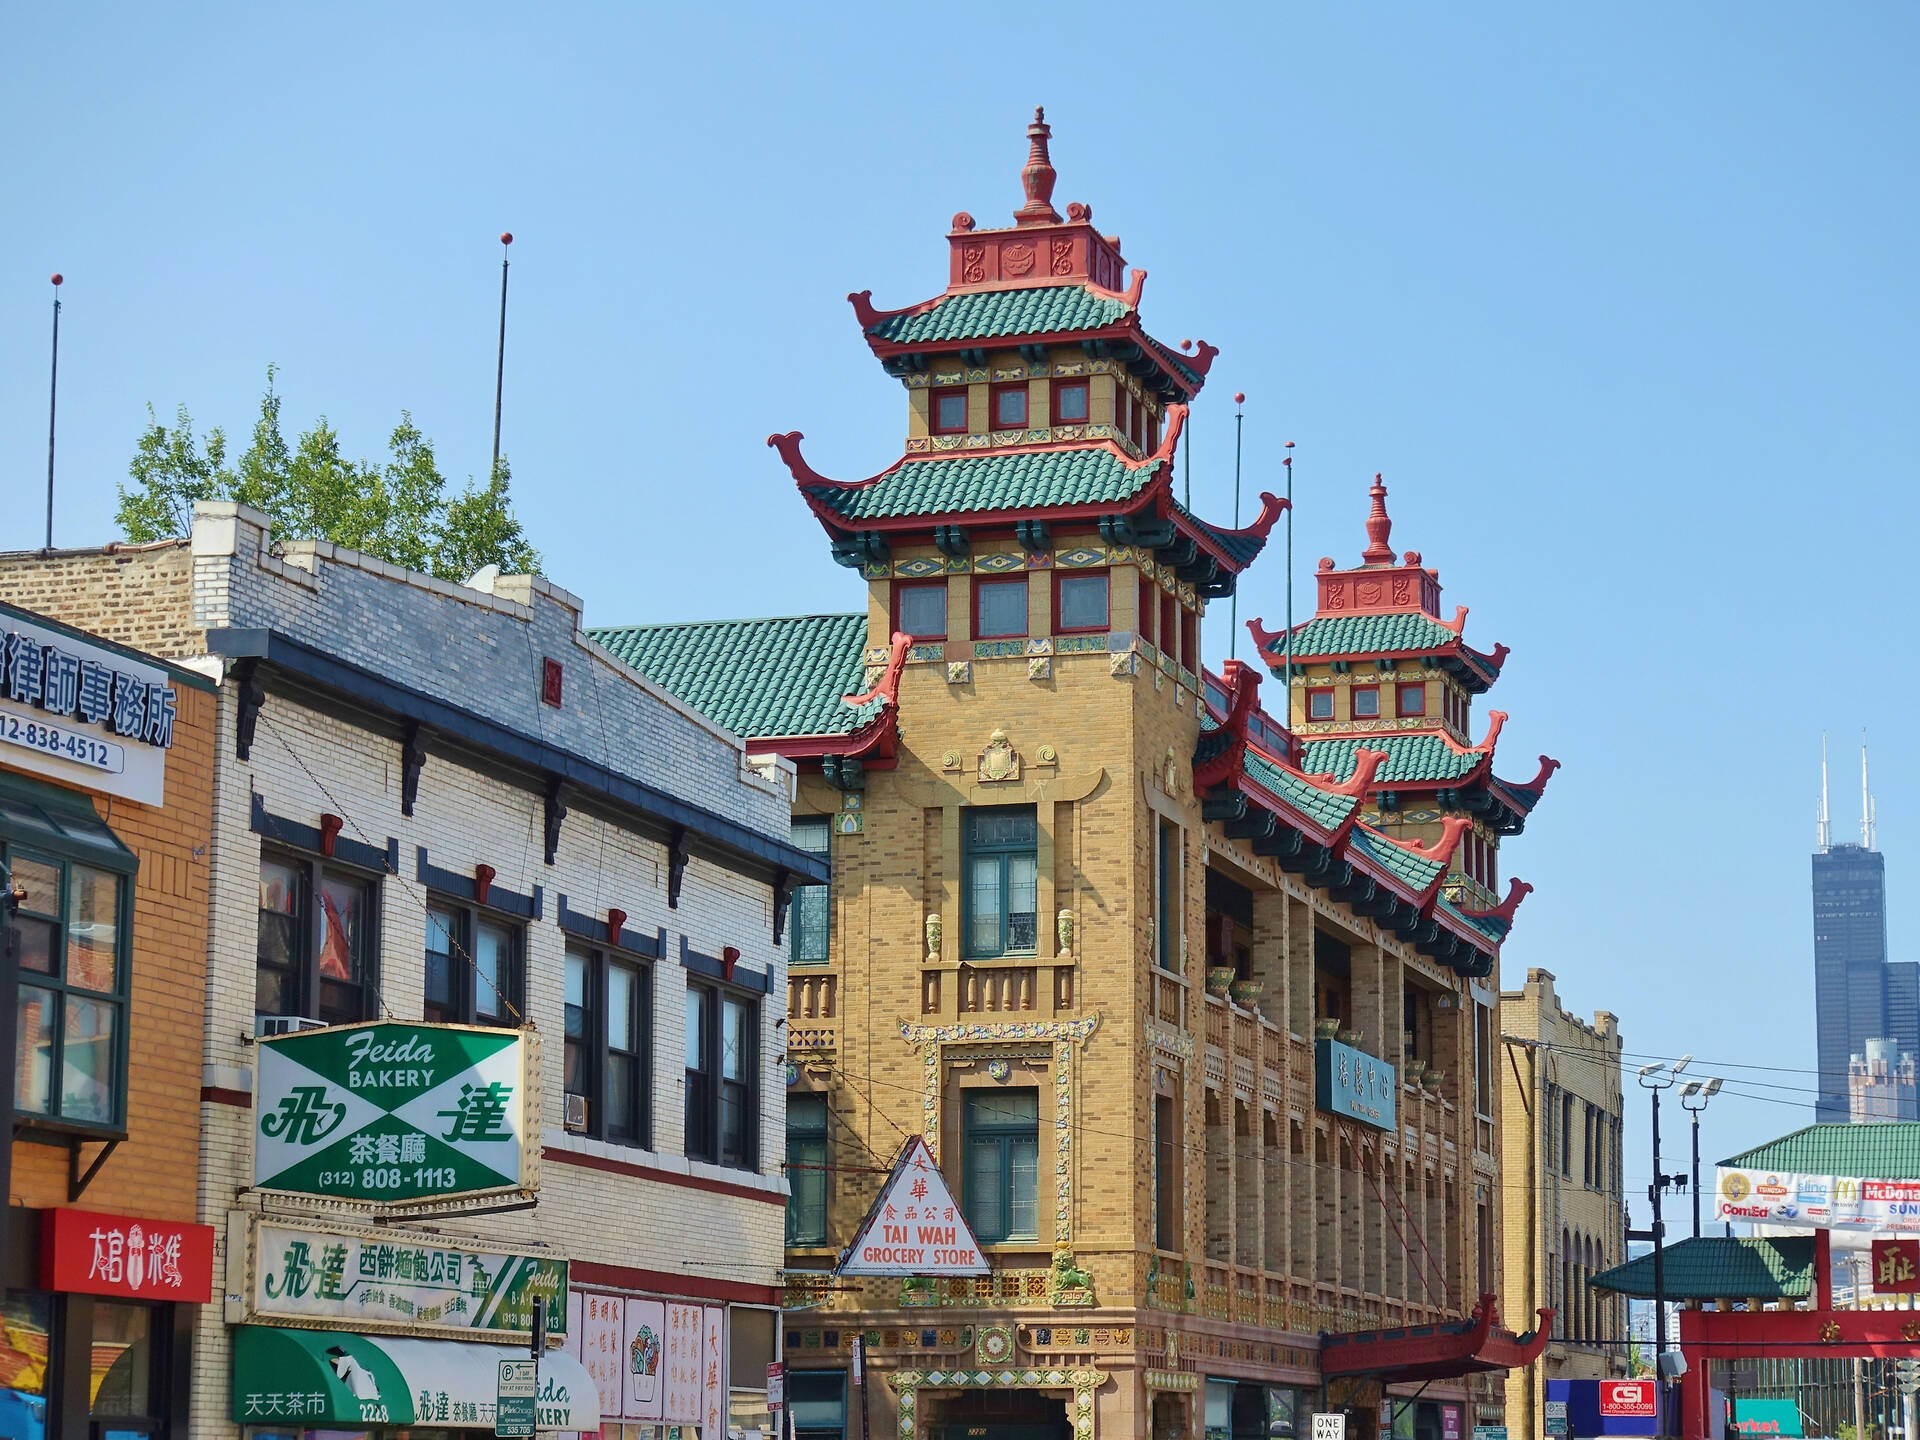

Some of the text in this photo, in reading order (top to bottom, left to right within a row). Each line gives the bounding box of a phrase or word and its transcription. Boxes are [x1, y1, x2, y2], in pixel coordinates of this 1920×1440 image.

[0, 629, 178, 749] 律師事務所
[345, 1031, 435, 1070] Feida
[349, 1069, 435, 1088] BAKERY
[349, 1132, 426, 1165] 茶餐廳
[318, 1171, 355, 1187] (312)
[882, 1203, 955, 1222] 食品公司
[1722, 1203, 1768, 1218] ComEd
[882, 1224, 956, 1245] TAI WAH
[863, 1246, 975, 1266] GROCERY STORE
[1612, 1386, 1642, 1403] CSI
[245, 1392, 326, 1417] 天天茶市
[537, 1408, 570, 1426] KERY
[1317, 1418, 1340, 1428] ONE
[1317, 1430, 1340, 1439] WAY
